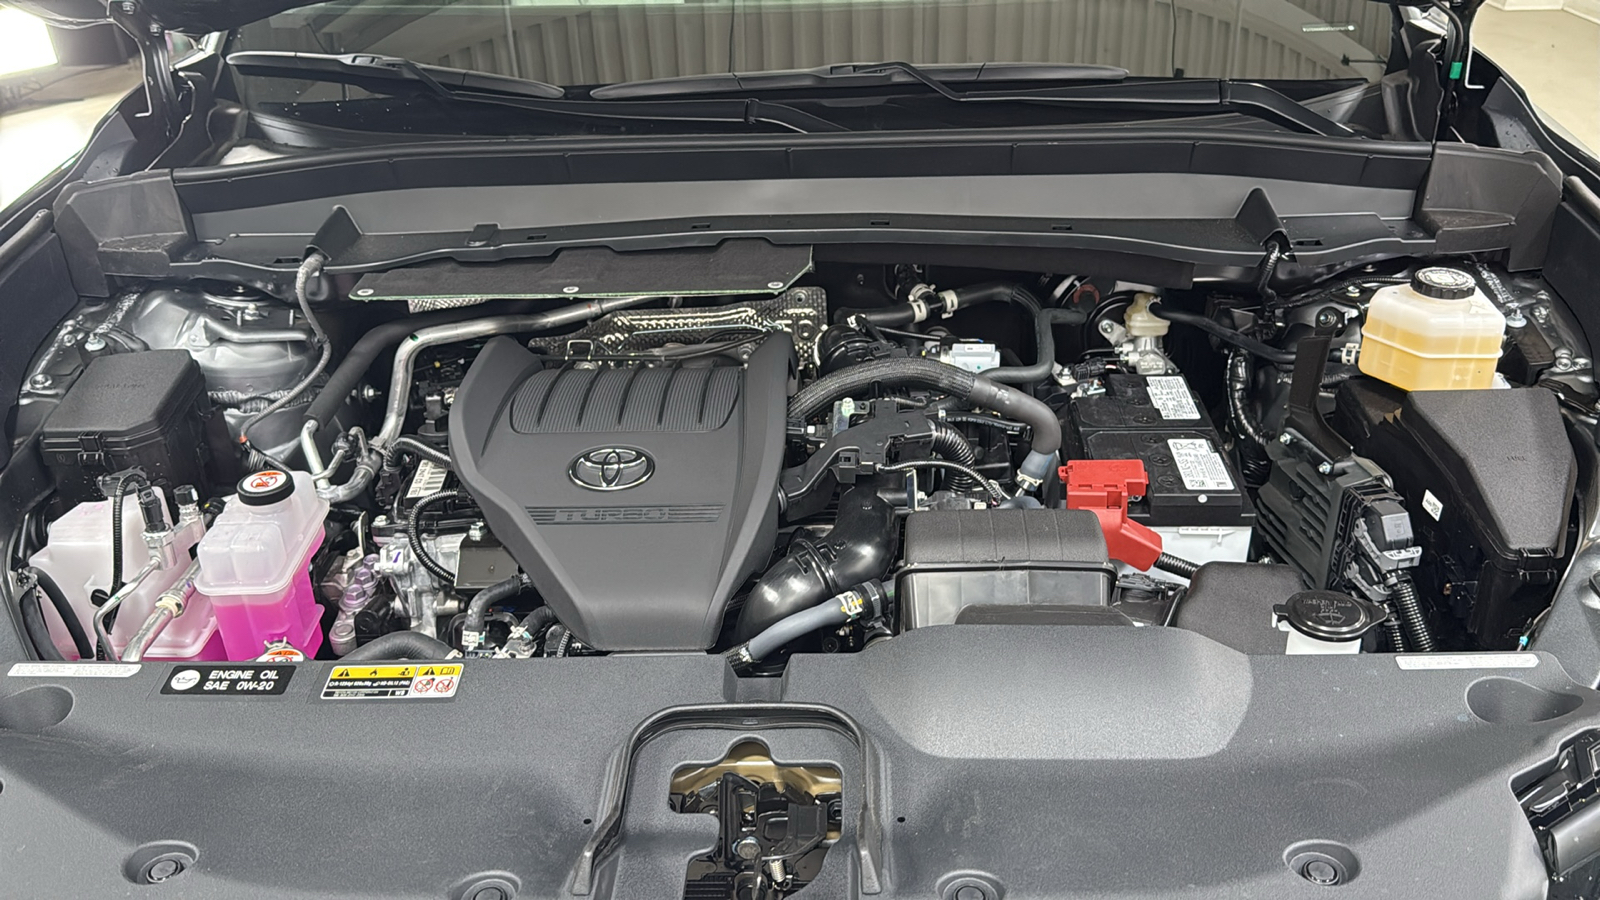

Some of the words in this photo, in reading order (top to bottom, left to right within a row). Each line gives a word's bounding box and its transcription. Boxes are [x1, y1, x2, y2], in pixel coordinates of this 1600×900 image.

[558, 508, 667, 521] TURBO
[208, 669, 255, 680] ENGINE
[260, 669, 279, 680] OIL
[203, 681, 231, 690] SAE
[236, 681, 275, 690] 0W-20
